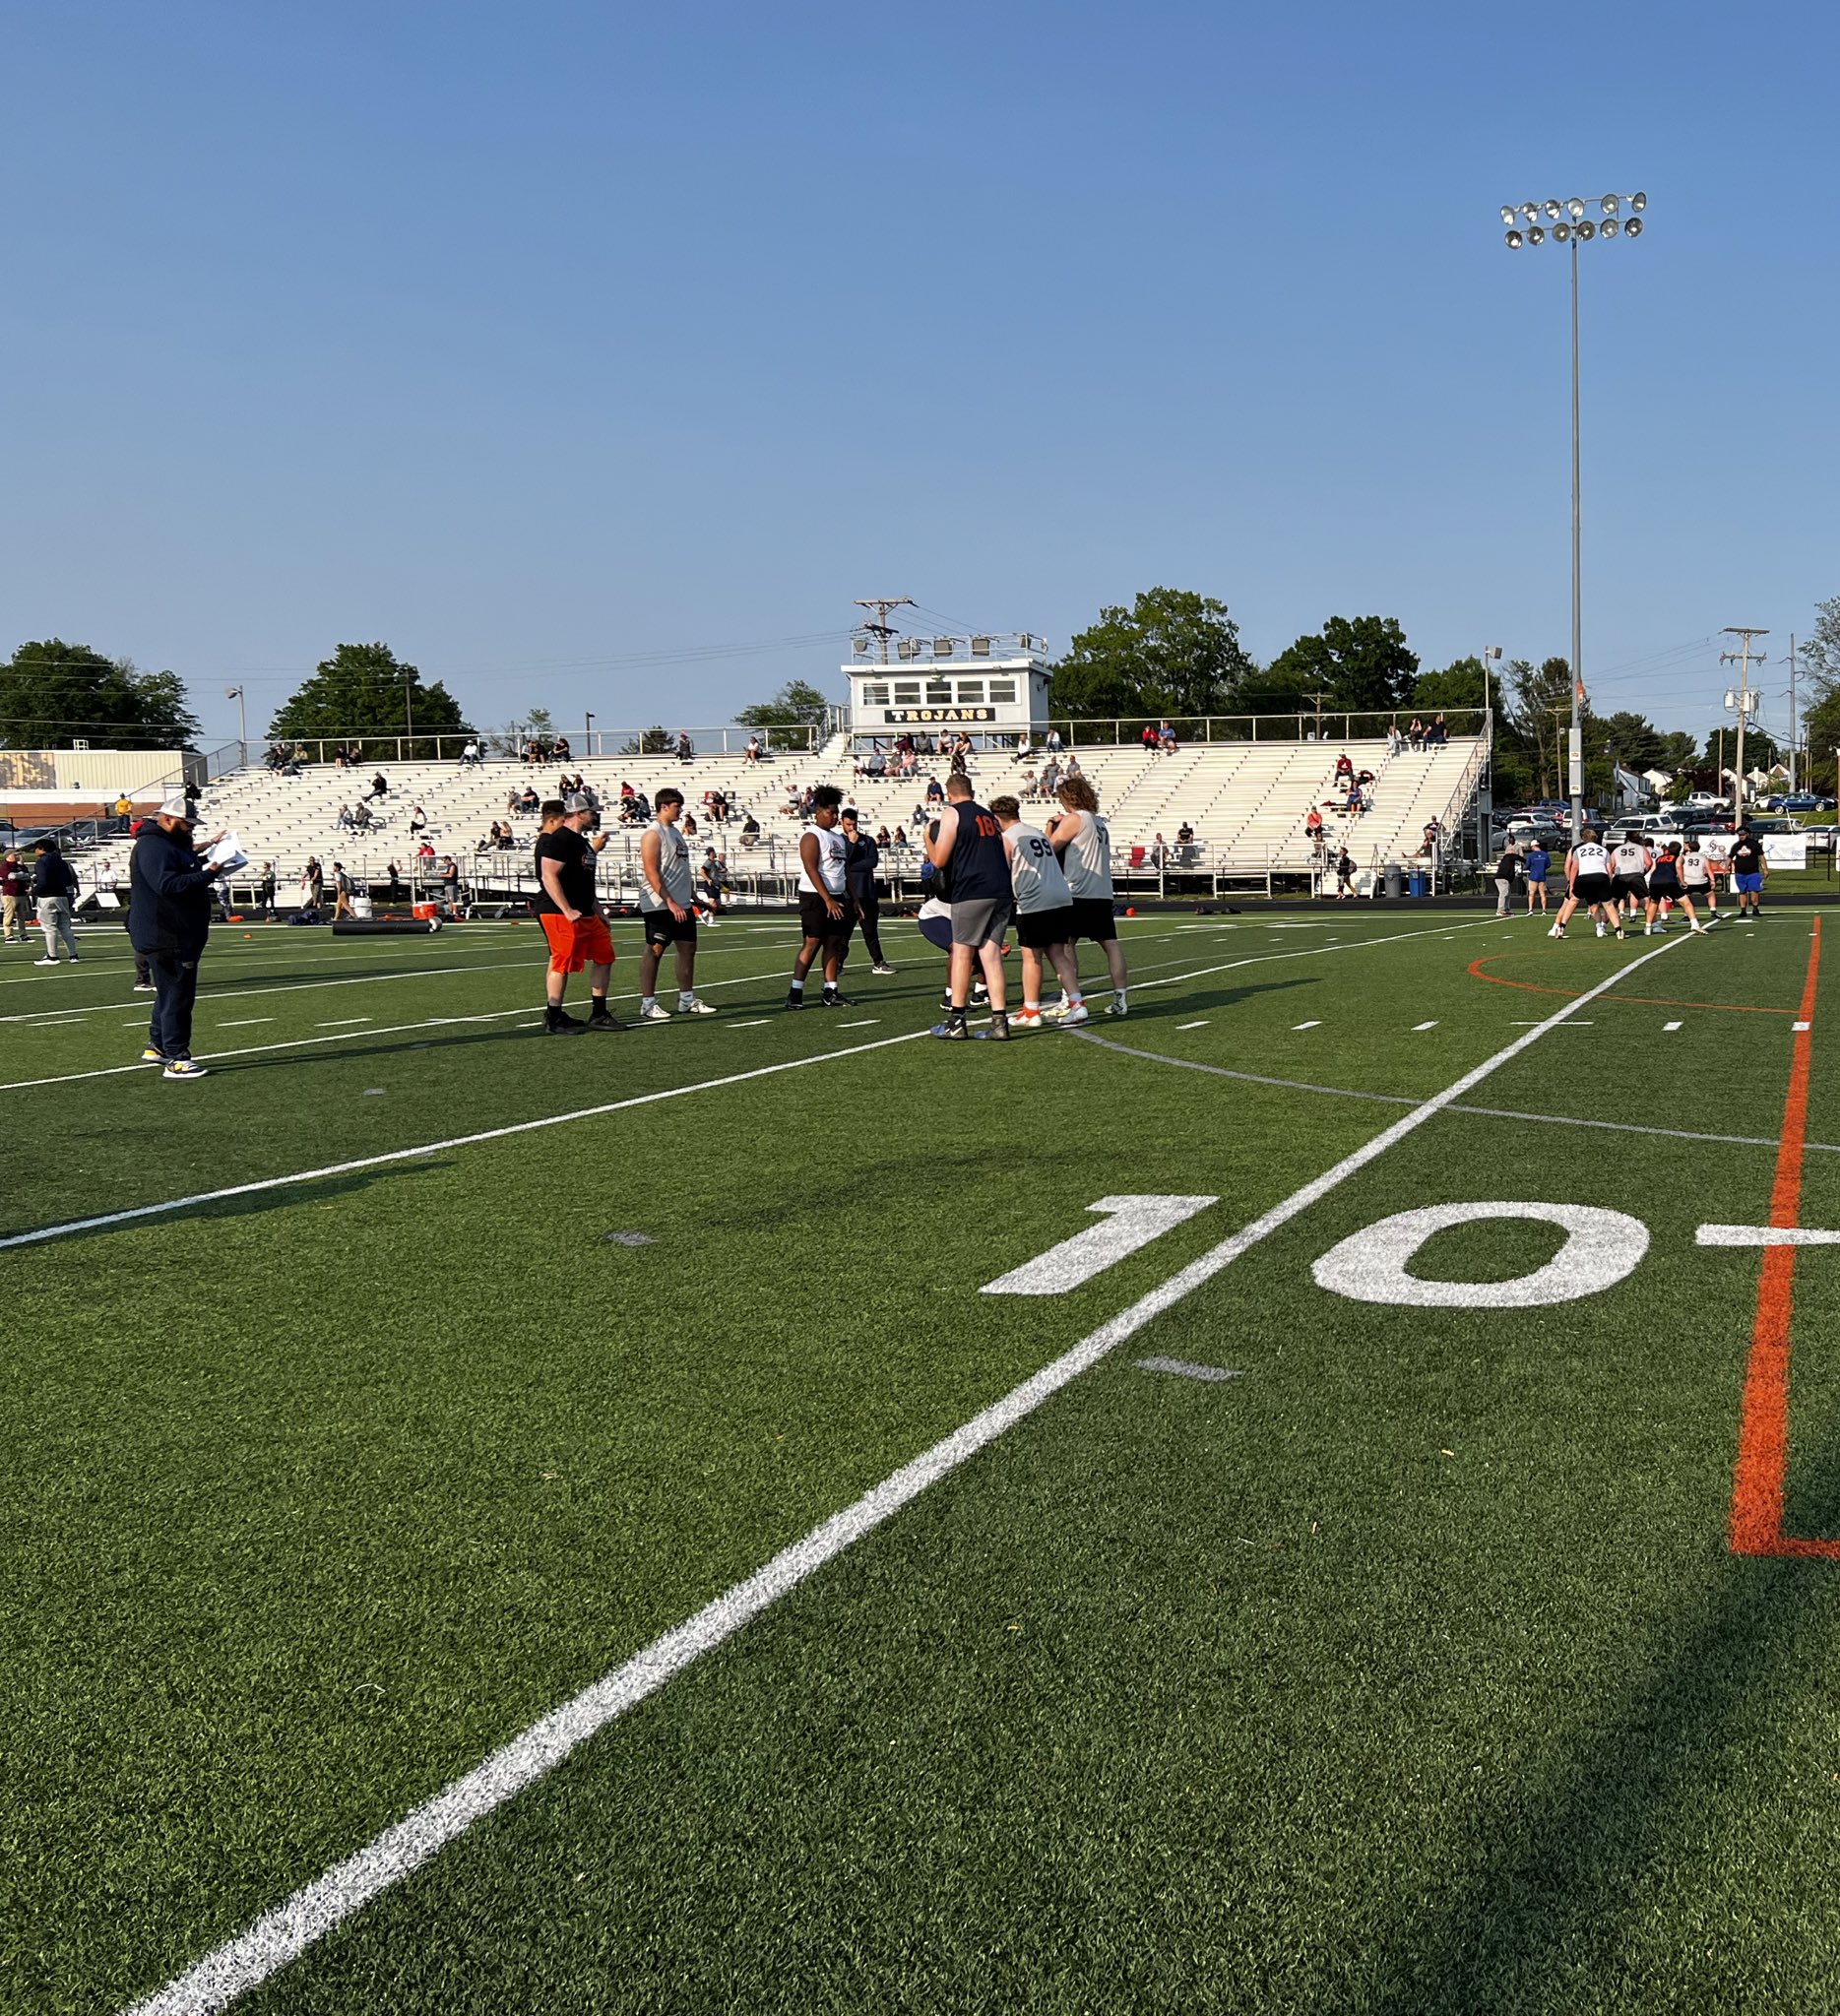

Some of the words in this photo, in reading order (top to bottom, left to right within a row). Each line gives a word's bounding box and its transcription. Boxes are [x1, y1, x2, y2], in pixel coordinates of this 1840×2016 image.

[891, 709, 987, 722] TROJANS
[1030, 838, 1052, 857] 99
[1579, 848, 1604, 857] 222
[1620, 848, 1635, 856] 95
